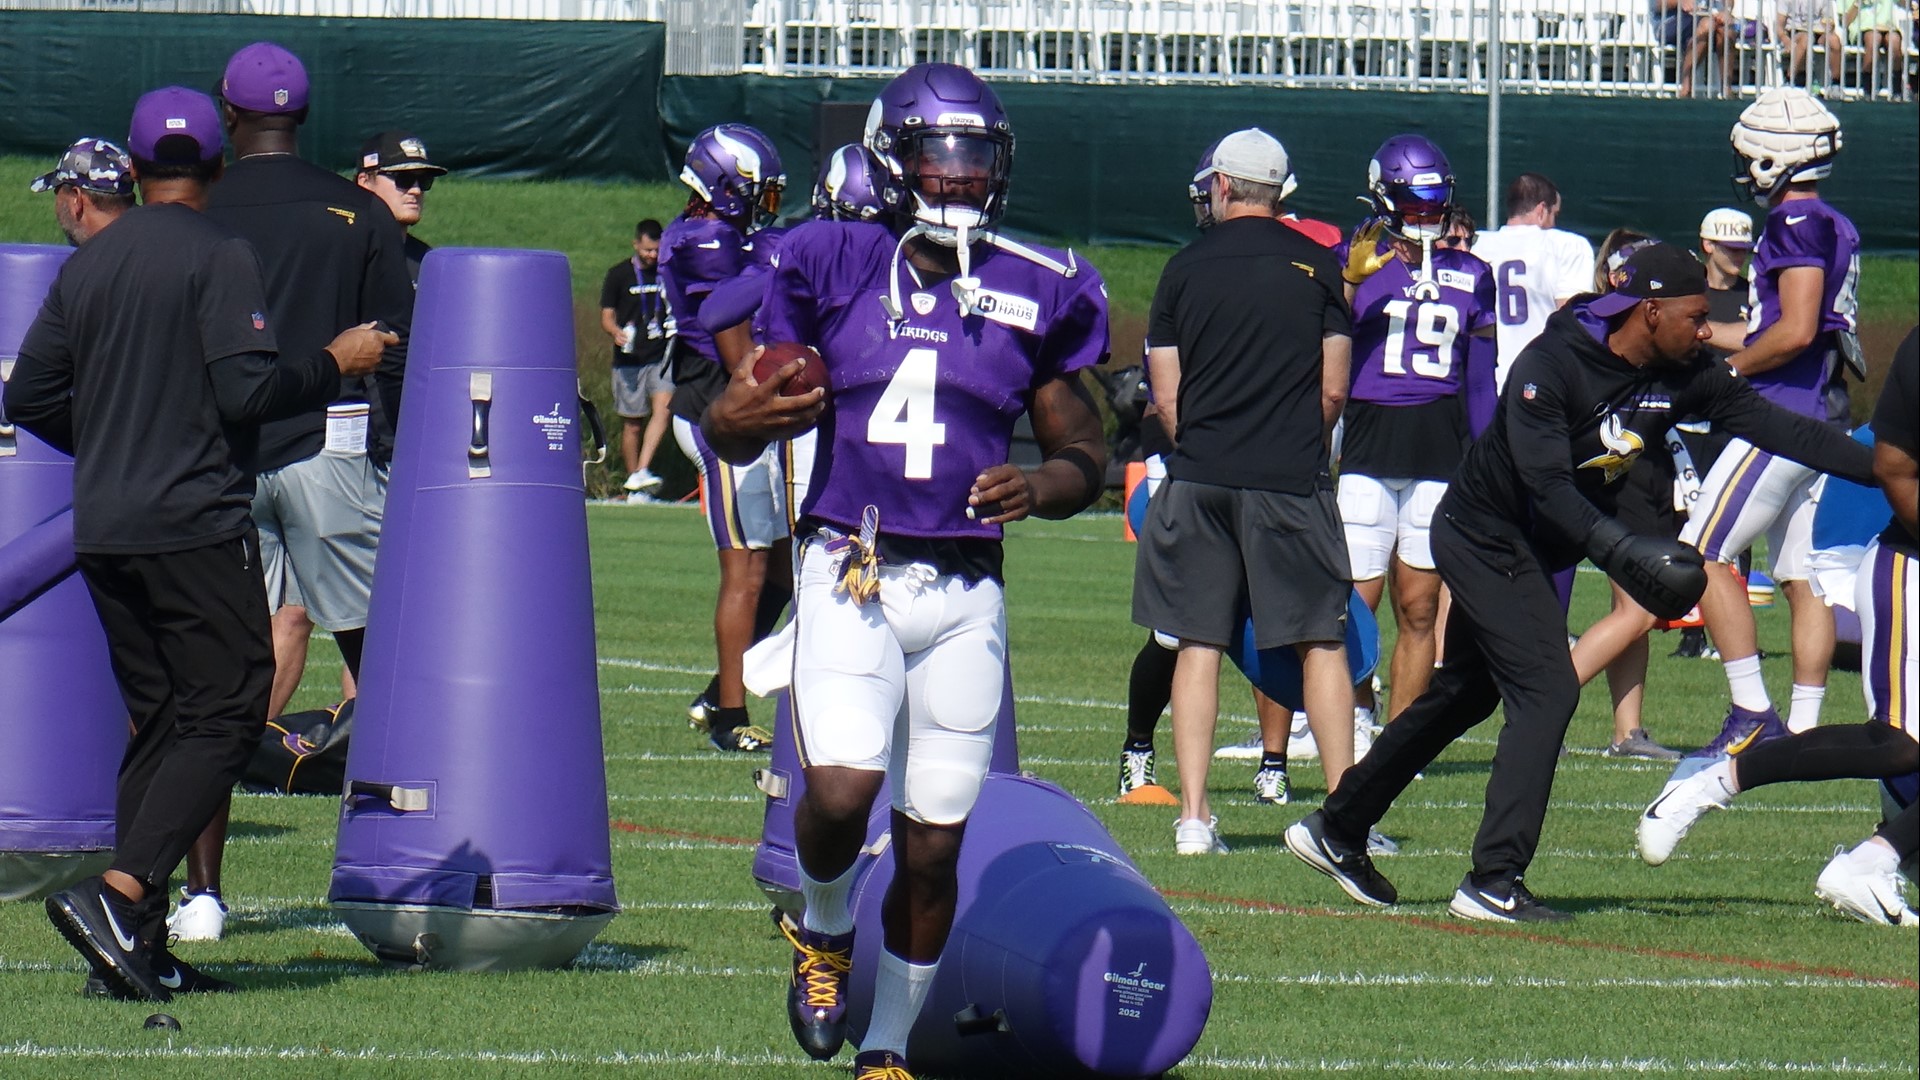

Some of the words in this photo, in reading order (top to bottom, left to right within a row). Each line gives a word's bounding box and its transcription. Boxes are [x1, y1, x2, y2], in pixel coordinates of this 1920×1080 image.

[998, 305, 1032, 320] HAUS
[1382, 299, 1459, 378] 19
[867, 348, 945, 479] 4
[1104, 972, 1139, 986] Gilman
[1140, 979, 1166, 991] Gear
[1118, 1007, 1141, 1018] 2022
